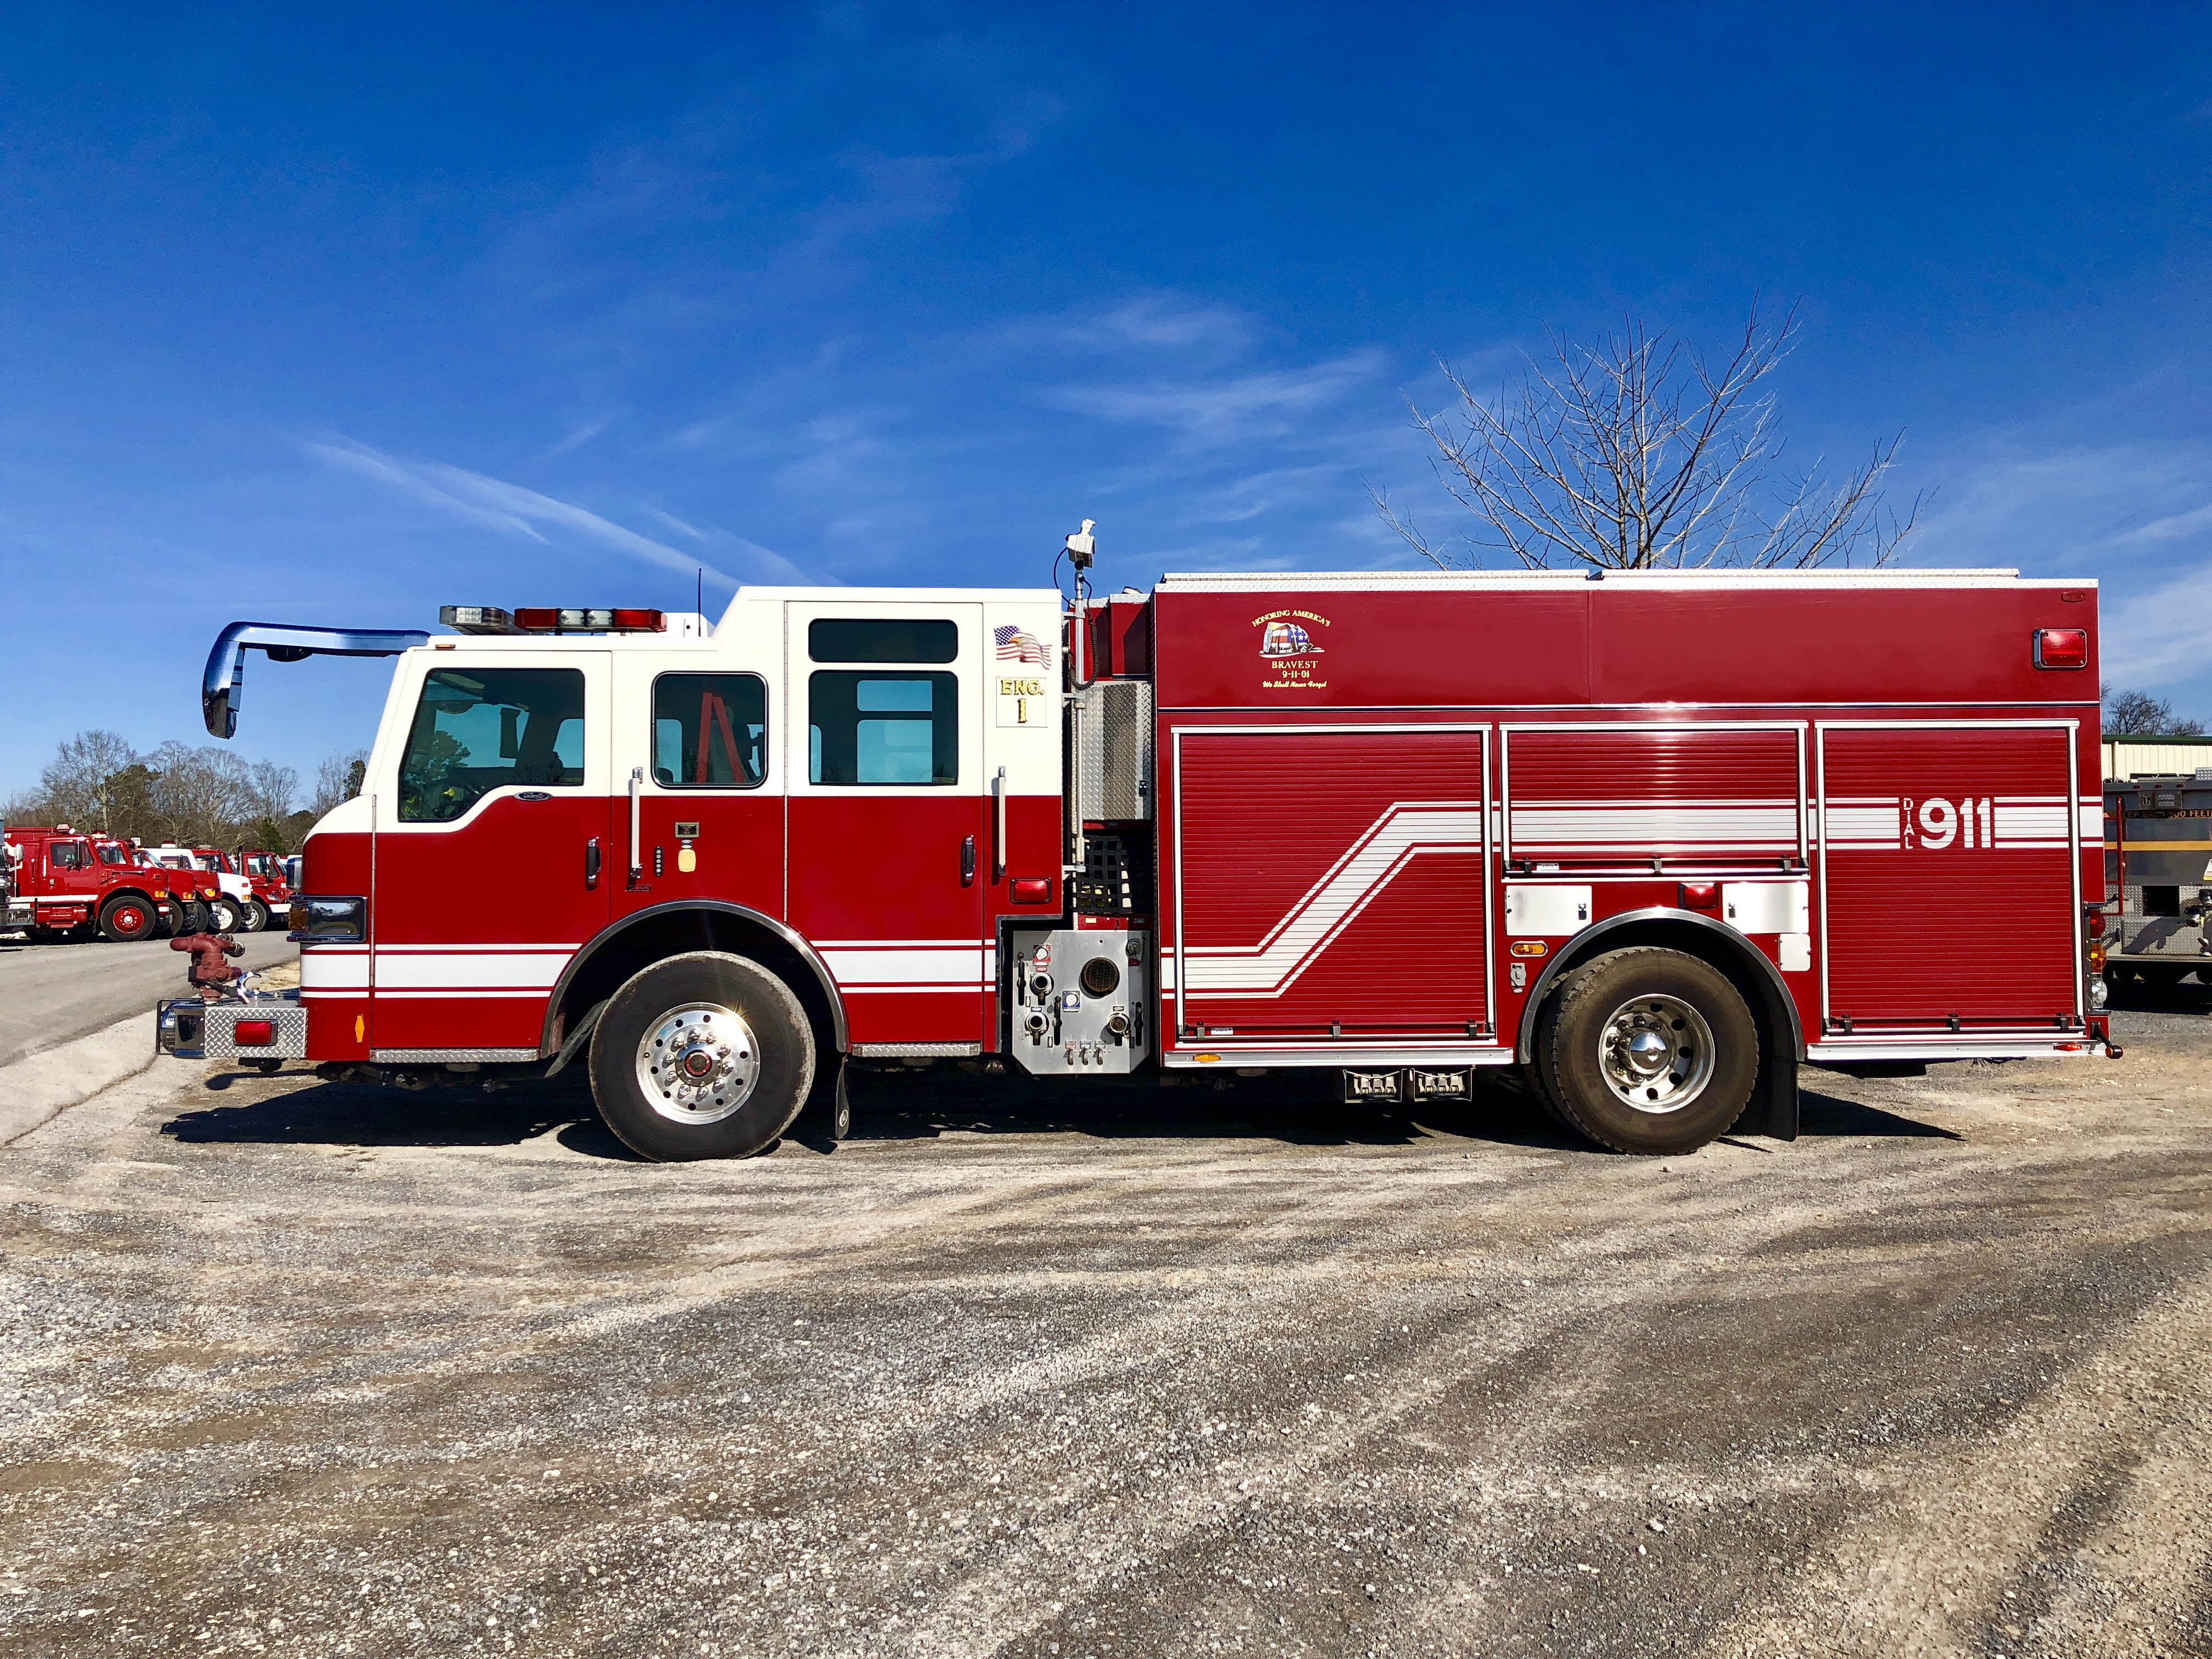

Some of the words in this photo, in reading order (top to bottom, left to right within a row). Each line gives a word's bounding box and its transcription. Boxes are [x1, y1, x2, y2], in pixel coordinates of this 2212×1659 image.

[1251, 610, 1290, 627] HONORING
[1292, 610, 1331, 627] AMERICA'S
[1272, 661, 1318, 669] BRAVEST
[1001, 680, 1045, 695] ENG.
[1017, 698, 1027, 723] 1
[1903, 797, 1915, 849] DIAL
[1919, 797, 1991, 849] 911
